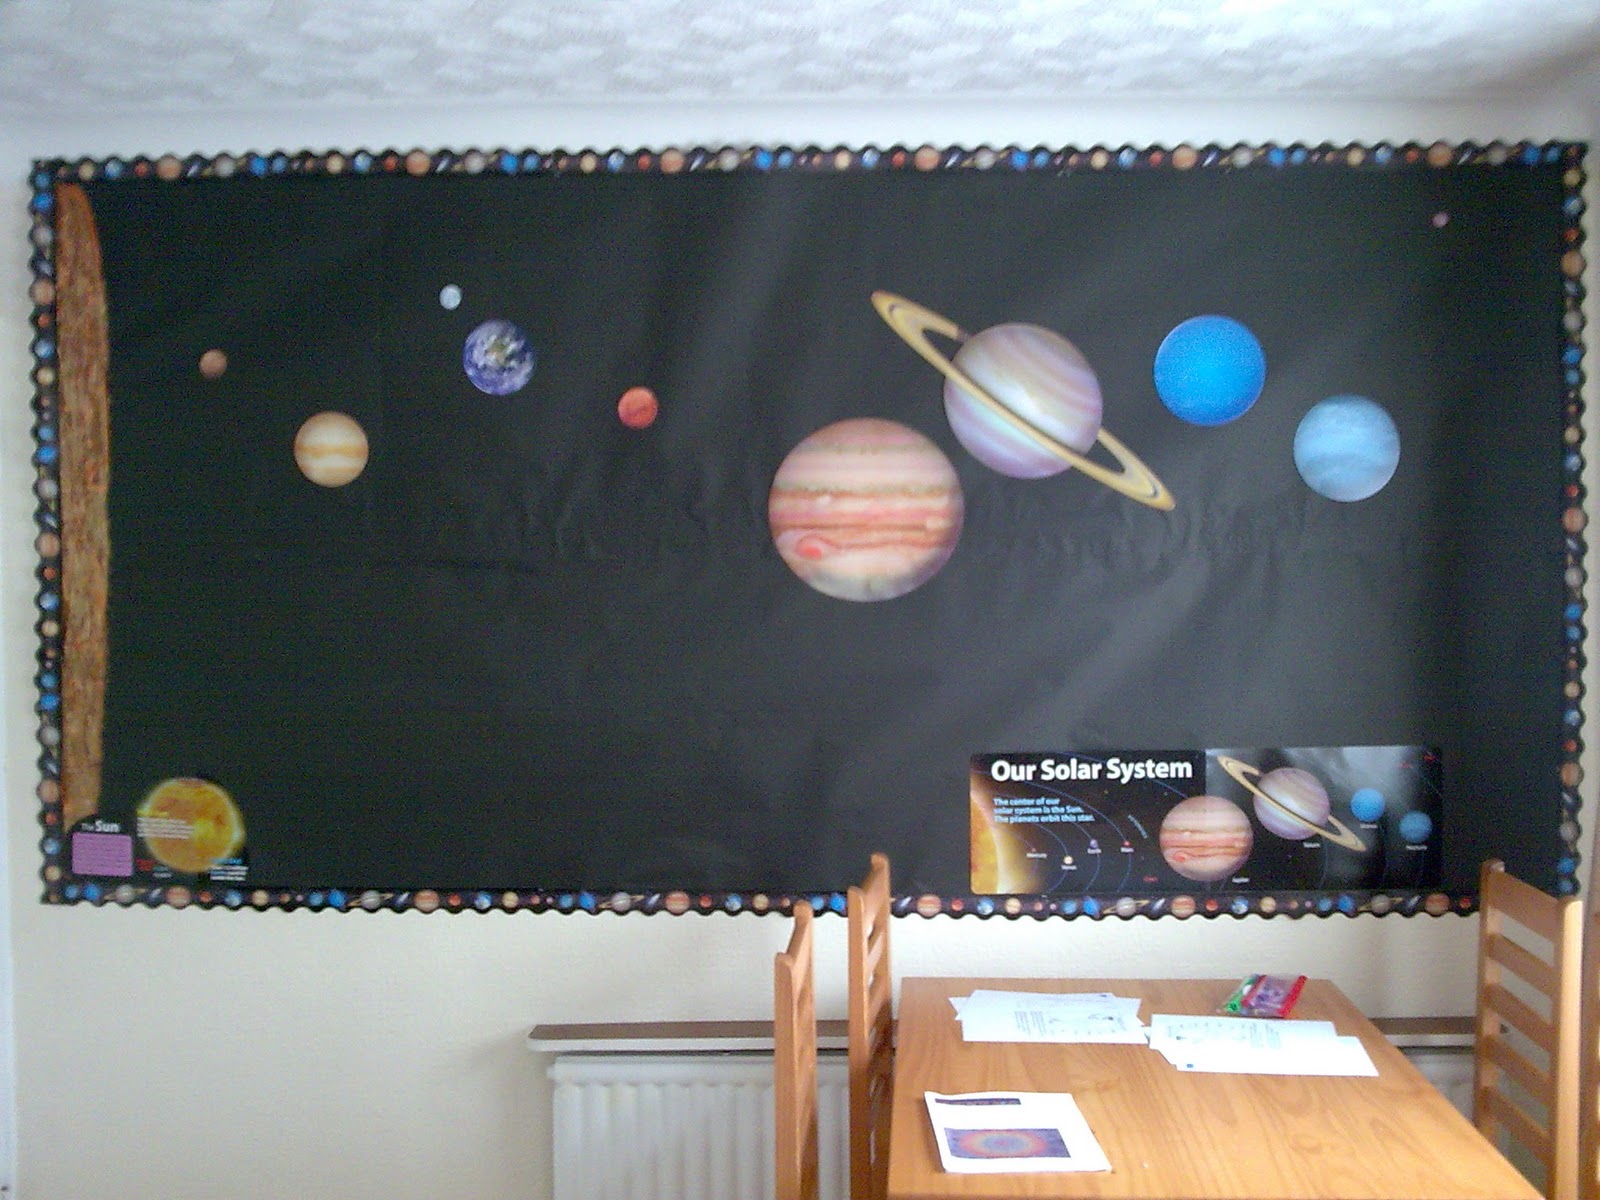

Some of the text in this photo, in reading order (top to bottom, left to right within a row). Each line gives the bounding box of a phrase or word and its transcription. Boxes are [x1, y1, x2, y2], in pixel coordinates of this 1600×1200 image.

[991, 757, 1192, 784] Our Solar System
[993, 797, 1009, 806] The
[1035, 796, 1045, 806] of
[1014, 806, 1043, 815] system
[994, 815, 1009, 823] The
[1009, 815, 1040, 824] planets
[95, 820, 119, 832] Sun
